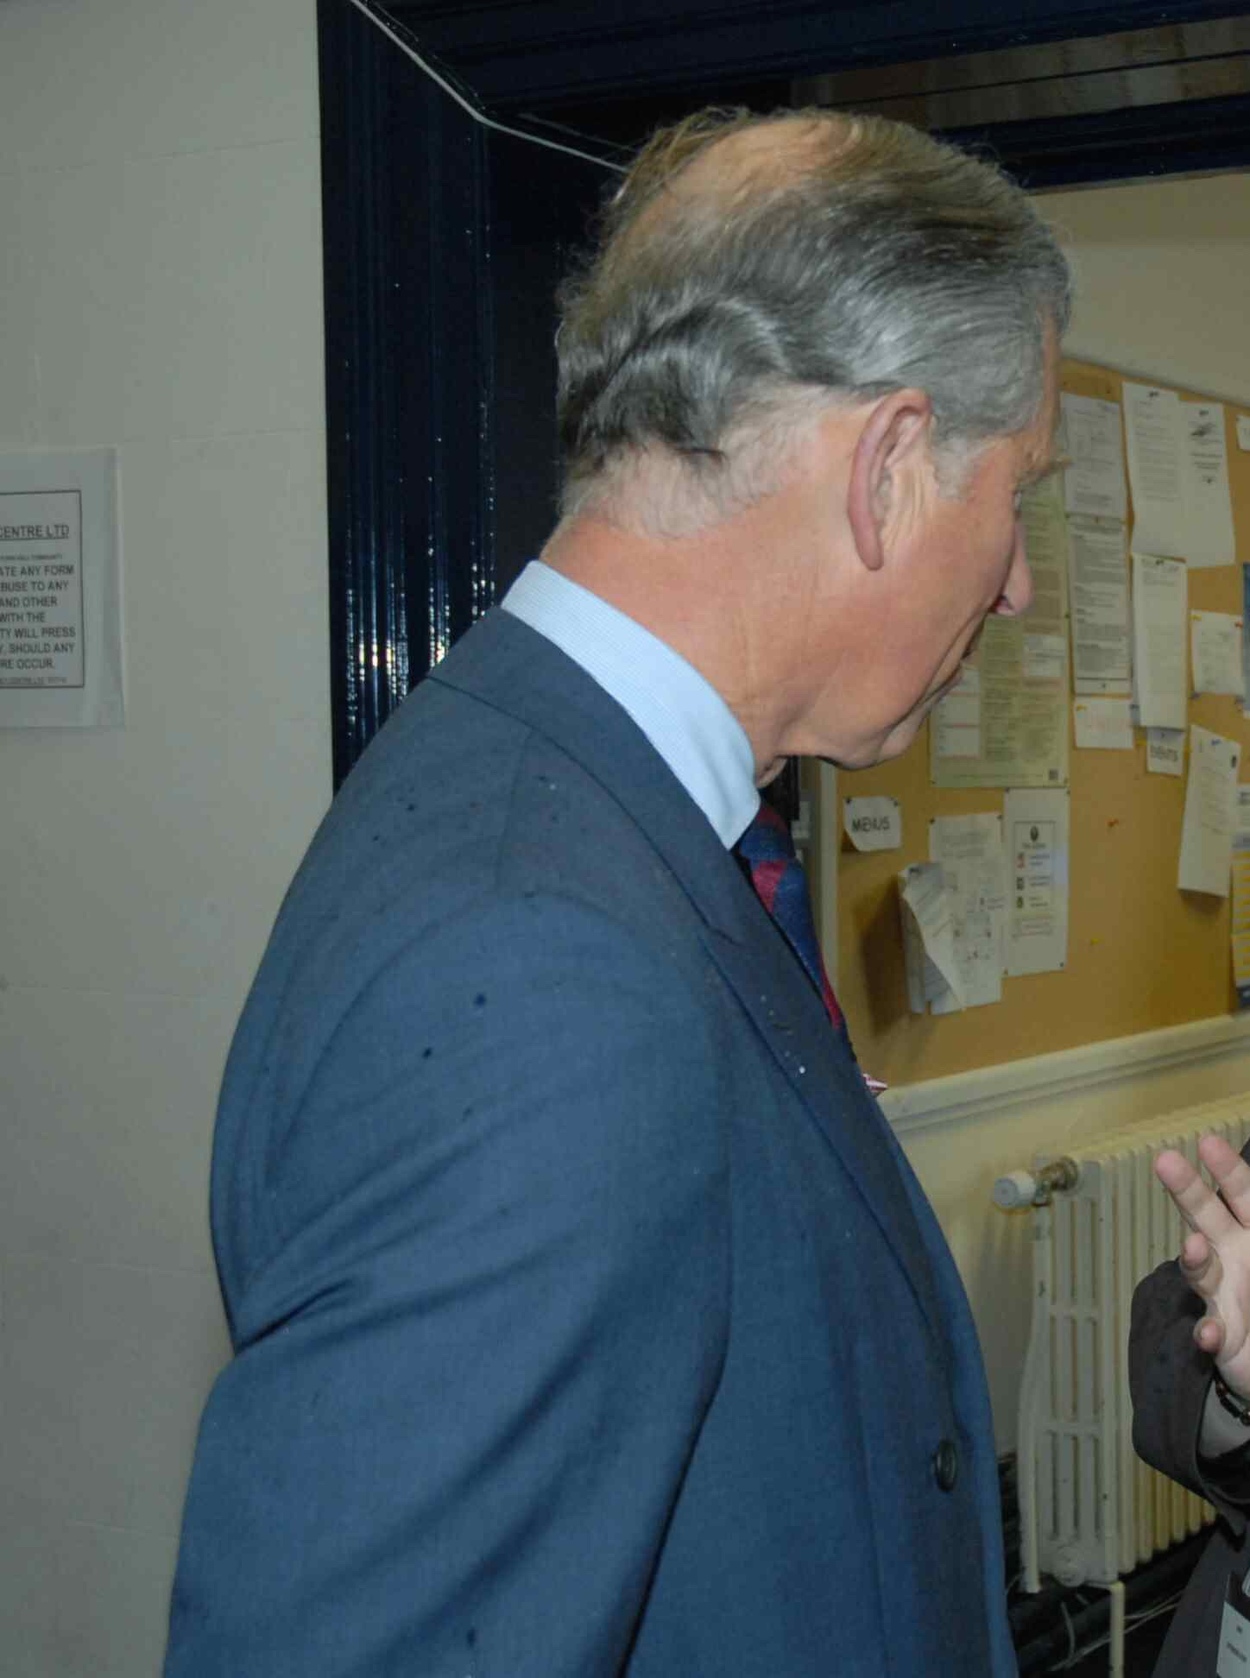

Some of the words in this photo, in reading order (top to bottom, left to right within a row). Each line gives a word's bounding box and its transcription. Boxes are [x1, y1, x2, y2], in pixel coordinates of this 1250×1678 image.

[46, 523, 70, 539] LTD
[20, 564, 42, 577] ANY
[44, 563, 75, 577] FORM
[31, 580, 46, 592] TO
[47, 579, 69, 592] ANY
[22, 595, 58, 608] OTHER
[26, 611, 46, 623] THE
[14, 627, 39, 639] WILL
[41, 625, 77, 638] PRESS
[8, 642, 52, 655] SHOULD
[53, 641, 76, 654] ANY
